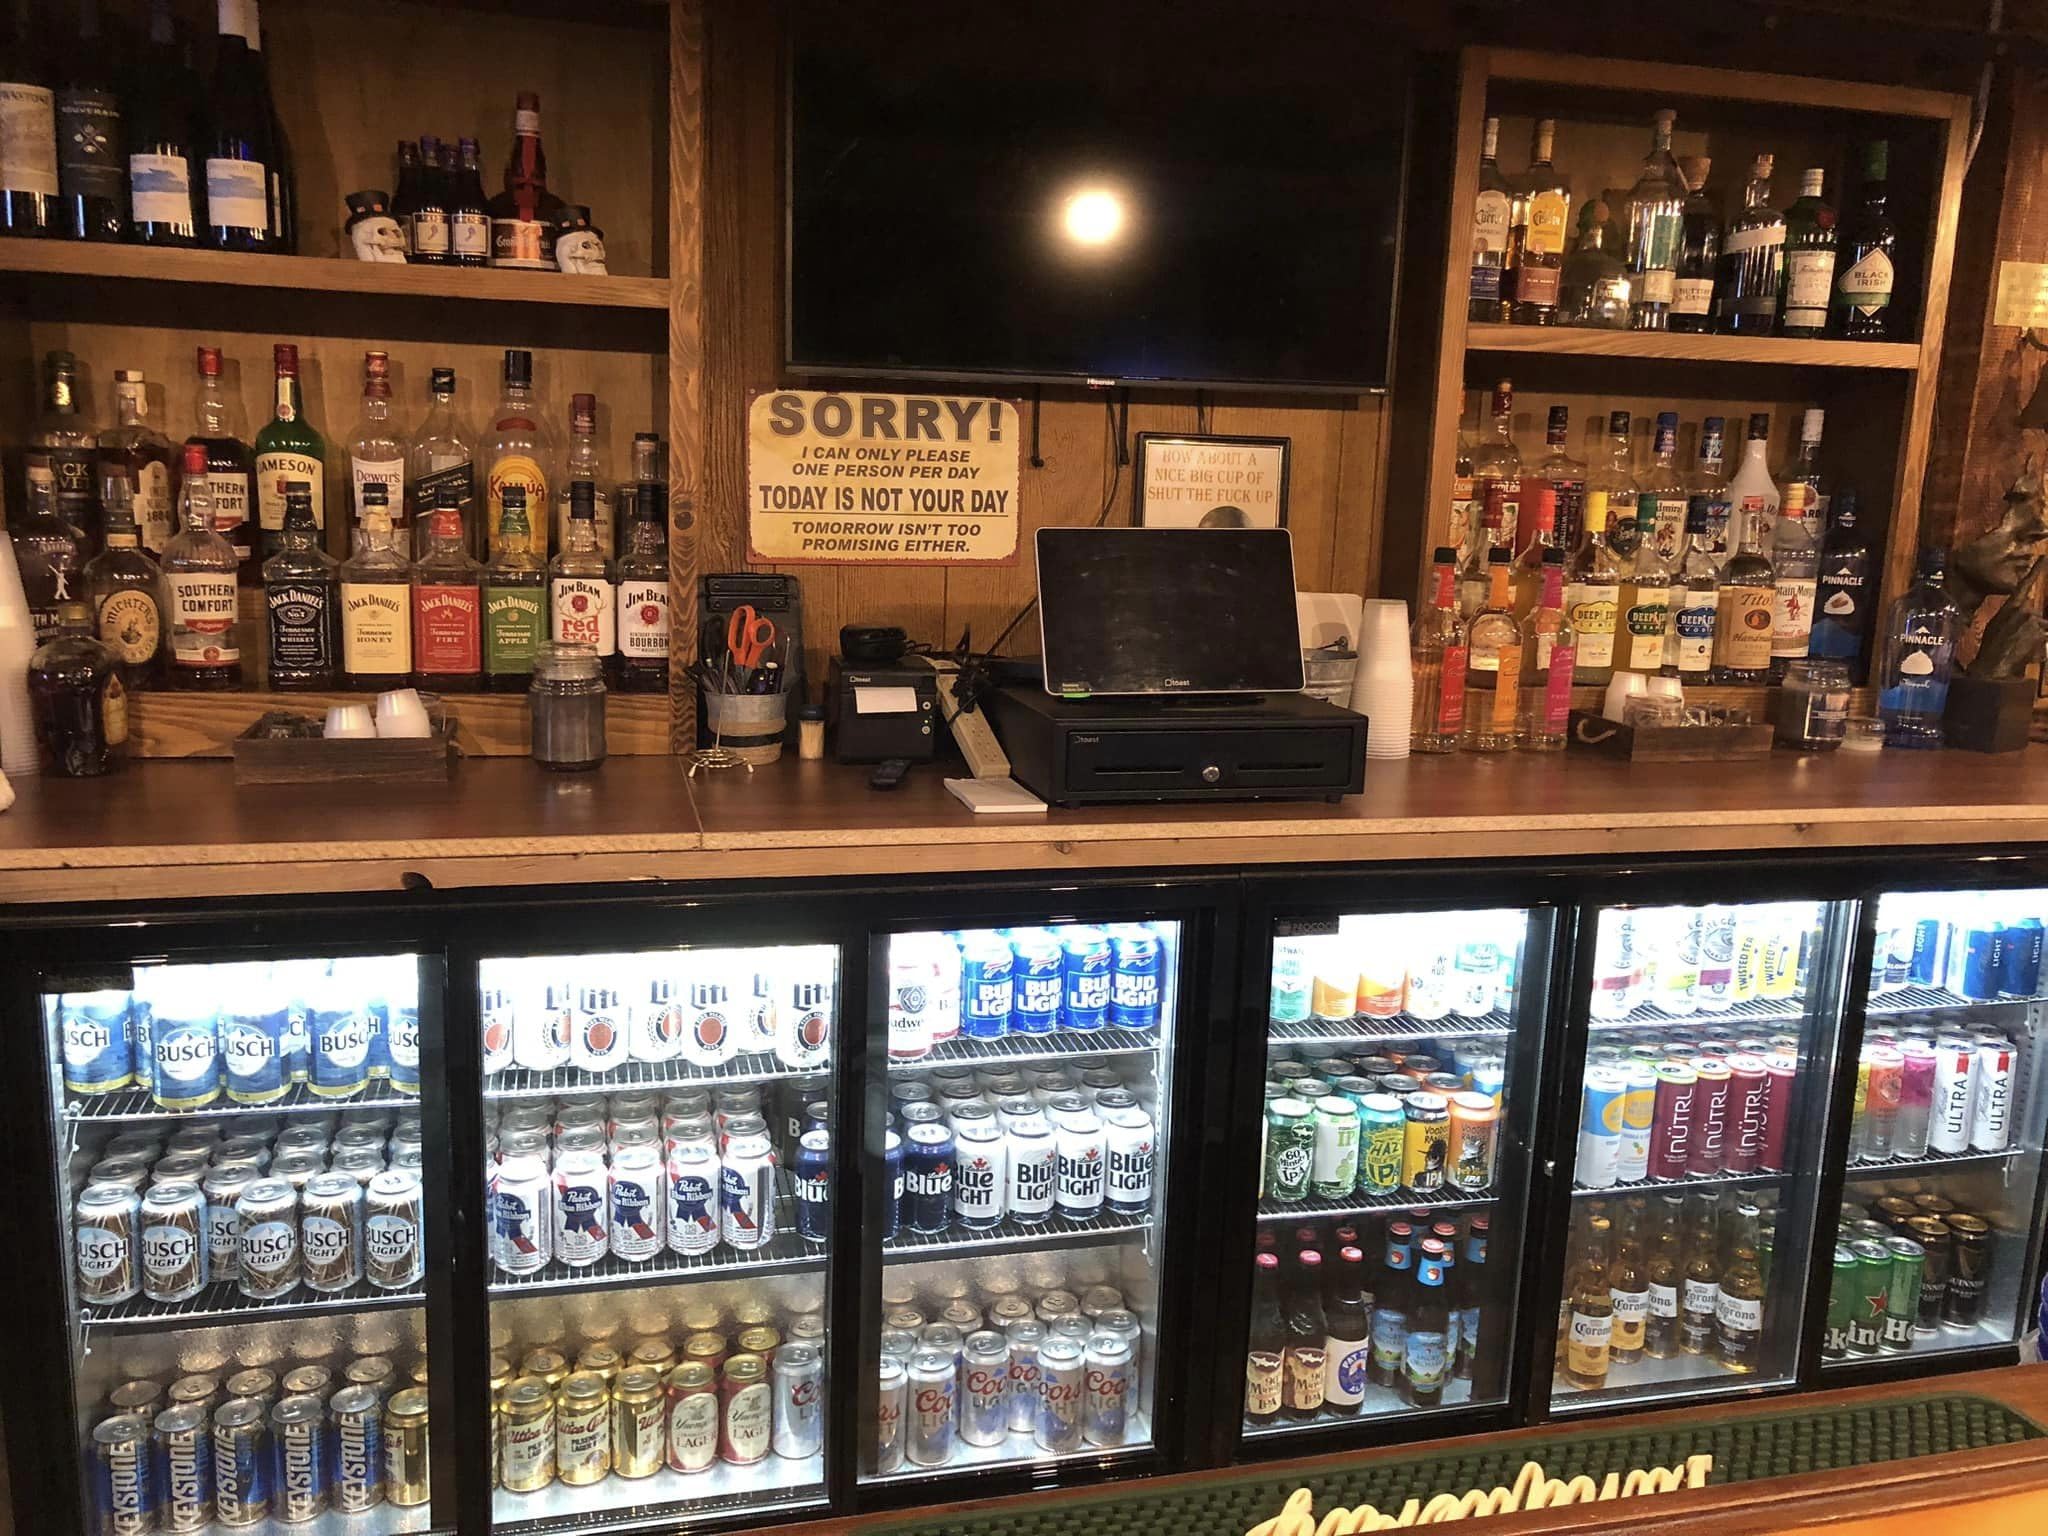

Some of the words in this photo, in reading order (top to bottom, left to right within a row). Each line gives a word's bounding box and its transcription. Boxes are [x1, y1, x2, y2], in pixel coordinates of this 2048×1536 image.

[767, 392, 1004, 443] SORRY!
[801, 446, 808, 459] I
[813, 446, 850, 460] CAN
[855, 447, 901, 461] ONLY
[905, 449, 971, 462] PLEASE
[1197, 450, 1242, 466] ABOUT
[257, 457, 316, 476] JAMESON
[792, 463, 829, 476] ONE
[834, 464, 904, 477] PERSON
[909, 466, 942, 479] PER
[947, 467, 980, 480] DAY
[356, 470, 401, 483] Dewar's
[1154, 468, 1186, 482] NICE
[1190, 469, 1214, 483] BIG
[1217, 470, 1243, 484] CUP
[1246, 471, 1264, 485] OF
[759, 485, 828, 511] TODAY
[834, 486, 854, 511] IS
[861, 487, 903, 512] NOT
[909, 488, 965, 513] YOUR
[971, 489, 1009, 513] DAY
[1147, 486, 1183, 501] SHUT
[1186, 488, 1213, 501] THE
[1217, 488, 1251, 502] FUCK
[1255, 490, 1273, 504] UP
[791, 521, 894, 535] TOMORROW
[898, 523, 942, 536] ISN'T
[947, 524, 981, 537] TOO
[802, 538, 899, 552] PROMISING
[904, 540, 970, 552] EITHER.
[1822, 575, 1864, 586] PINNACLE
[177, 584, 235, 598] SOUTHERN
[268, 592, 288, 609] JACK
[289, 588, 324, 609] DANIEL'S
[558, 584, 575, 599] JIM
[576, 581, 601, 599] BEAM
[182, 598, 233, 612] COMFORT
[348, 598, 369, 613] JACK
[369, 593, 401, 613] DANIEL'S
[421, 598, 441, 613] JACK
[441, 594, 474, 613] DANIEL'S
[488, 599, 507, 615] JACK
[507, 596, 539, 615] DANIEL'S
[625, 592, 646, 609] JIM
[1577, 610, 1599, 620] DEEP
[1632, 612, 1654, 622] DEEP
[1681, 614, 1702, 625] DEEP
[562, 615, 599, 633] red
[561, 632, 600, 644] STAG
[1900, 633, 1944, 646] PINNACLE
[1992, 939, 2002, 967] LIGHT
[2031, 936, 2041, 964] LIGHT
[1115, 973, 1157, 991] BUD
[157, 1039, 218, 1062] BUSCH
[1947, 1078, 1968, 1133] ULTRA
[1990, 1077, 2009, 1132] ULTRA
[1110, 1150, 1153, 1173] Blue
[1285, 1149, 1300, 1161] 60
[1058, 1154, 1104, 1179] Blue
[679, 1180, 702, 1193] Pabst
[903, 1169, 953, 1196] Blue
[1057, 1175, 1103, 1196] LIGHT
[1463, 1175, 1481, 1184] IPA
[567, 1190, 592, 1203] Pabst
[615, 1184, 637, 1197] Pabst
[240, 1232, 297, 1256] BUSCH
[305, 1247, 337, 1258] LIGHT
[371, 1244, 405, 1255] LIGHT
[148, 1256, 185, 1268] LIGHT
[250, 1252, 288, 1265] LIGHT
[339, 1411, 370, 1511] KEYSTONE
[214, 1423, 241, 1525] KEYSTONE
[284, 1422, 315, 1520] KEYSTONE
[170, 1431, 203, 1530] KEYSTONE
